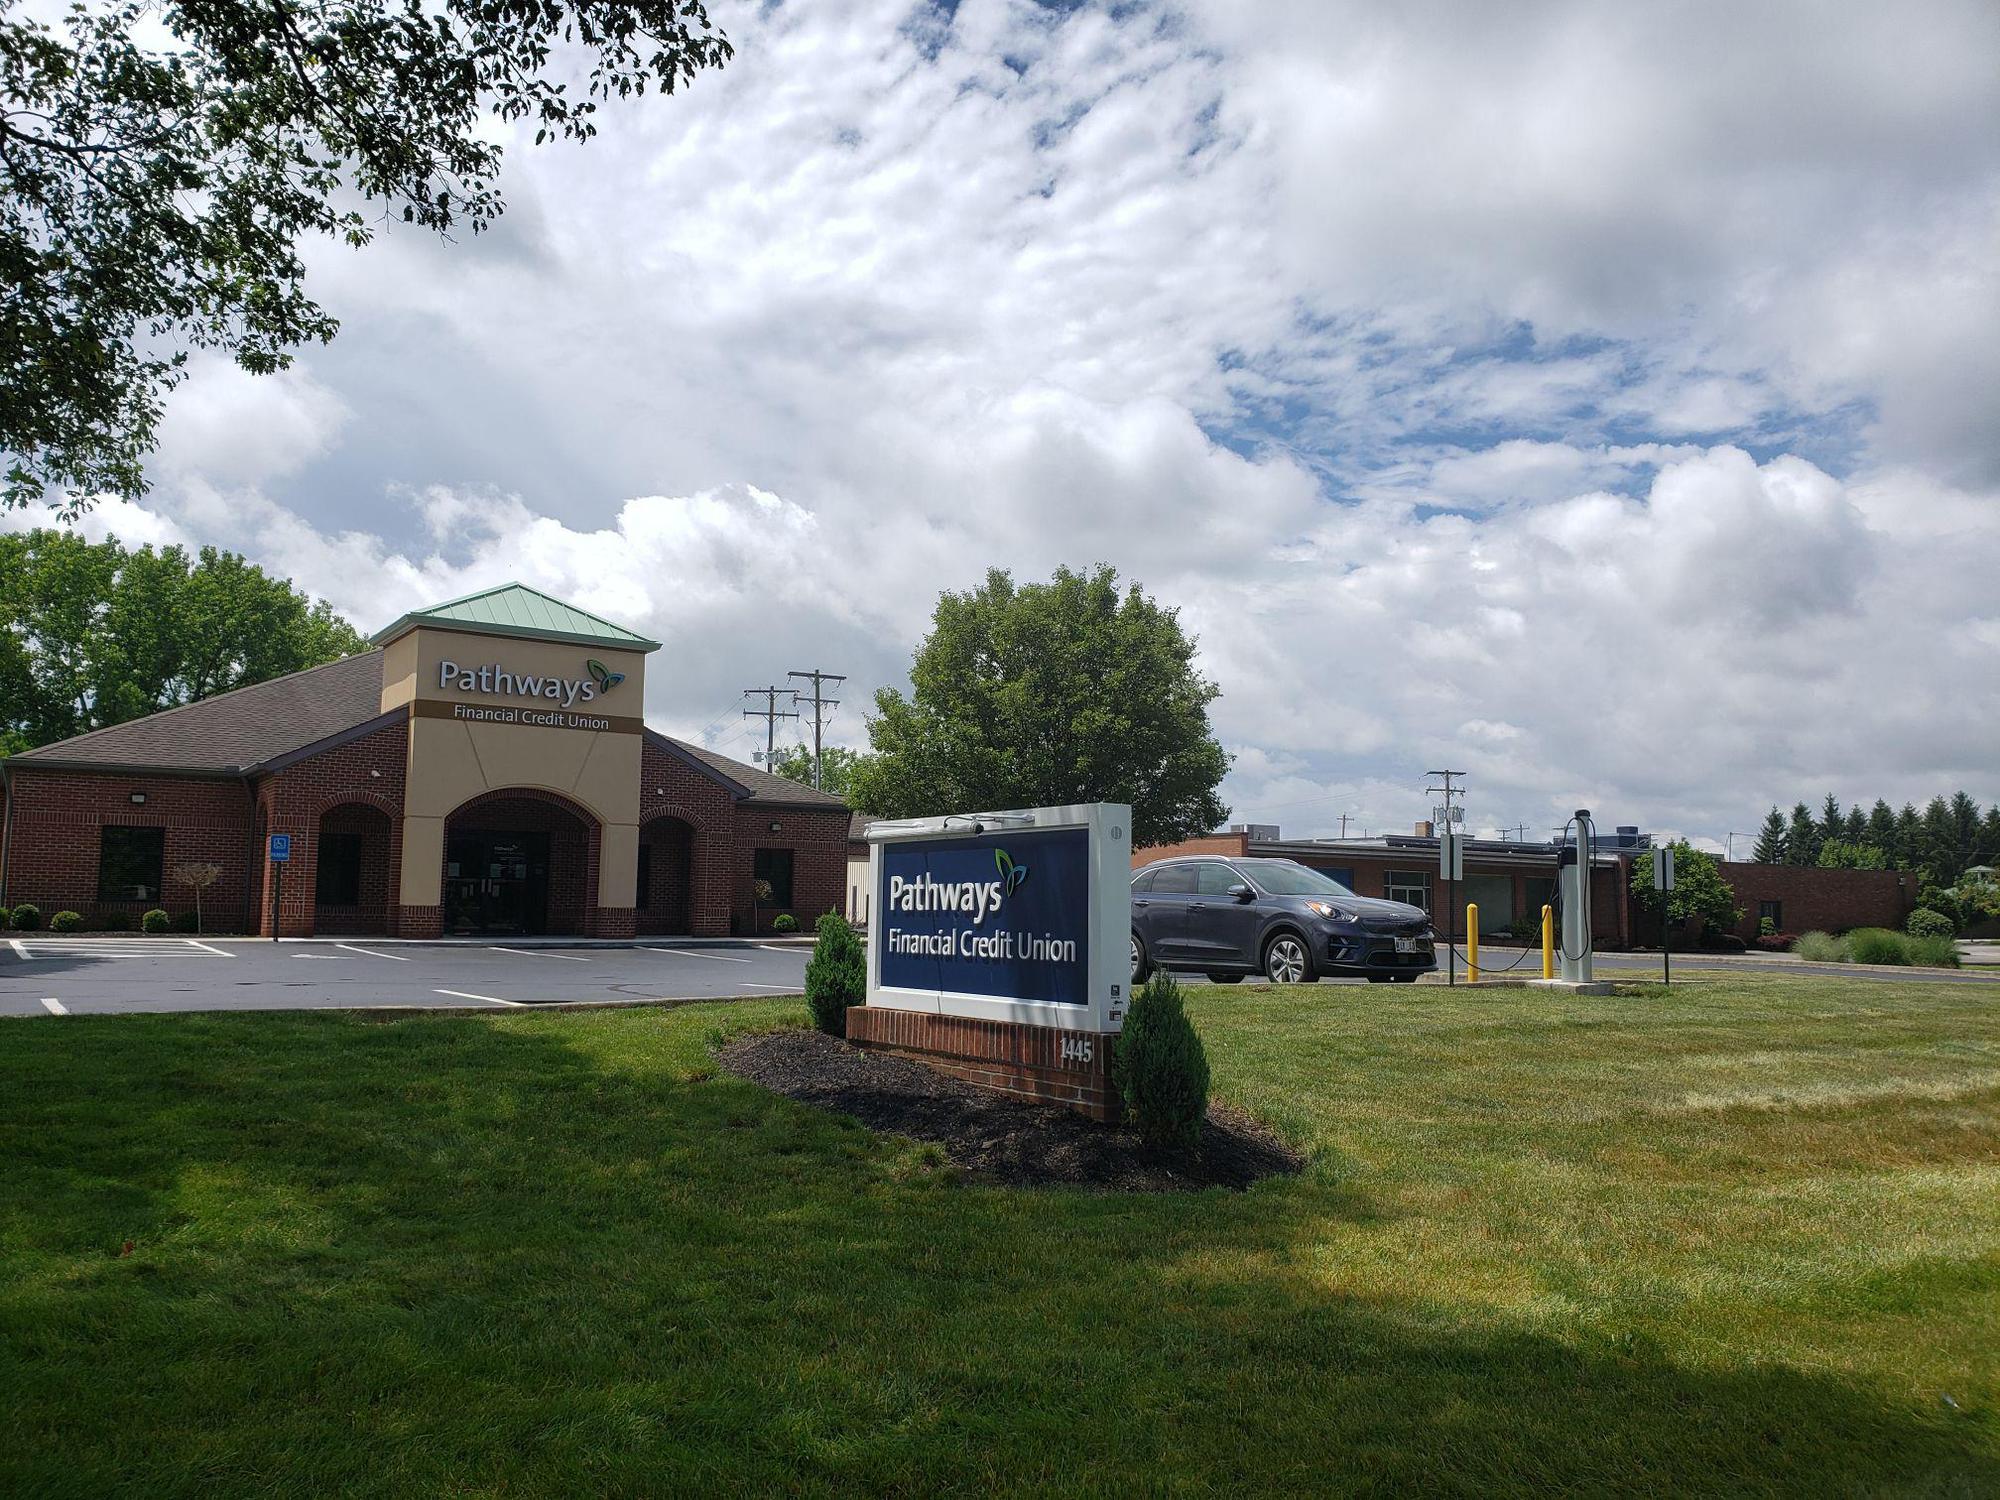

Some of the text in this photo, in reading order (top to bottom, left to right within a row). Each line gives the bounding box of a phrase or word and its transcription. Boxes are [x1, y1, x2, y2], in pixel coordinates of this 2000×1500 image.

[439, 660, 594, 708] Pathways
[454, 705, 609, 730] Financial Credit Union
[889, 872, 1002, 925] Pathways
[888, 928, 1076, 962] Financial Credit Union
[1060, 1037, 1093, 1063] 1445
